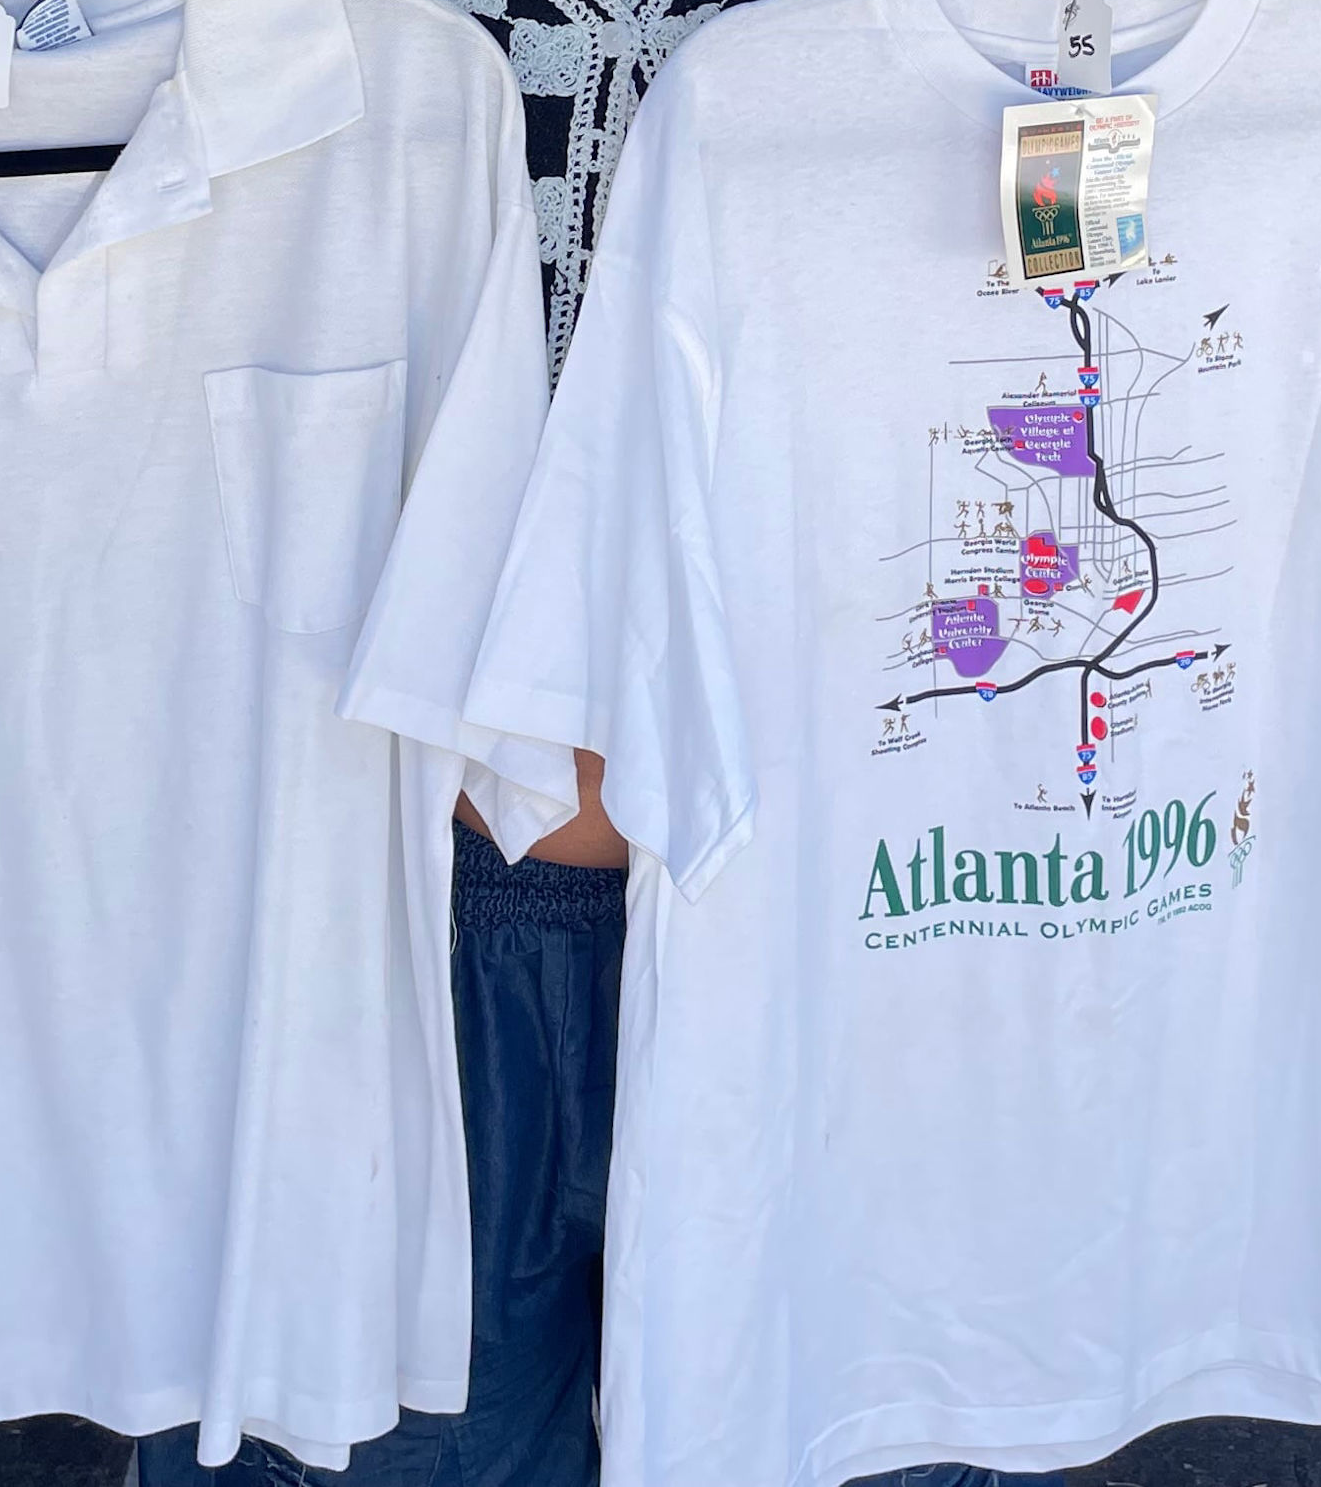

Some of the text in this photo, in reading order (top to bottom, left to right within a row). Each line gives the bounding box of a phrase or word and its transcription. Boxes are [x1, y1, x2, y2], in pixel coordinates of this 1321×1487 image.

[1080, 288, 1091, 297] 85
[1049, 297, 1061, 305] 75
[1083, 375, 1095, 384] 75
[1083, 396, 1096, 406] 85
[1025, 413, 1071, 425] Olympic
[1021, 553, 1068, 566] Olympic
[1025, 567, 1062, 579] Center
[858, 790, 1217, 921] Atlanta 1996
[865, 920, 1028, 950] CENTENNIAL
[1040, 910, 1140, 940] OLYMPIC
[1147, 883, 1212, 918] GAMES
